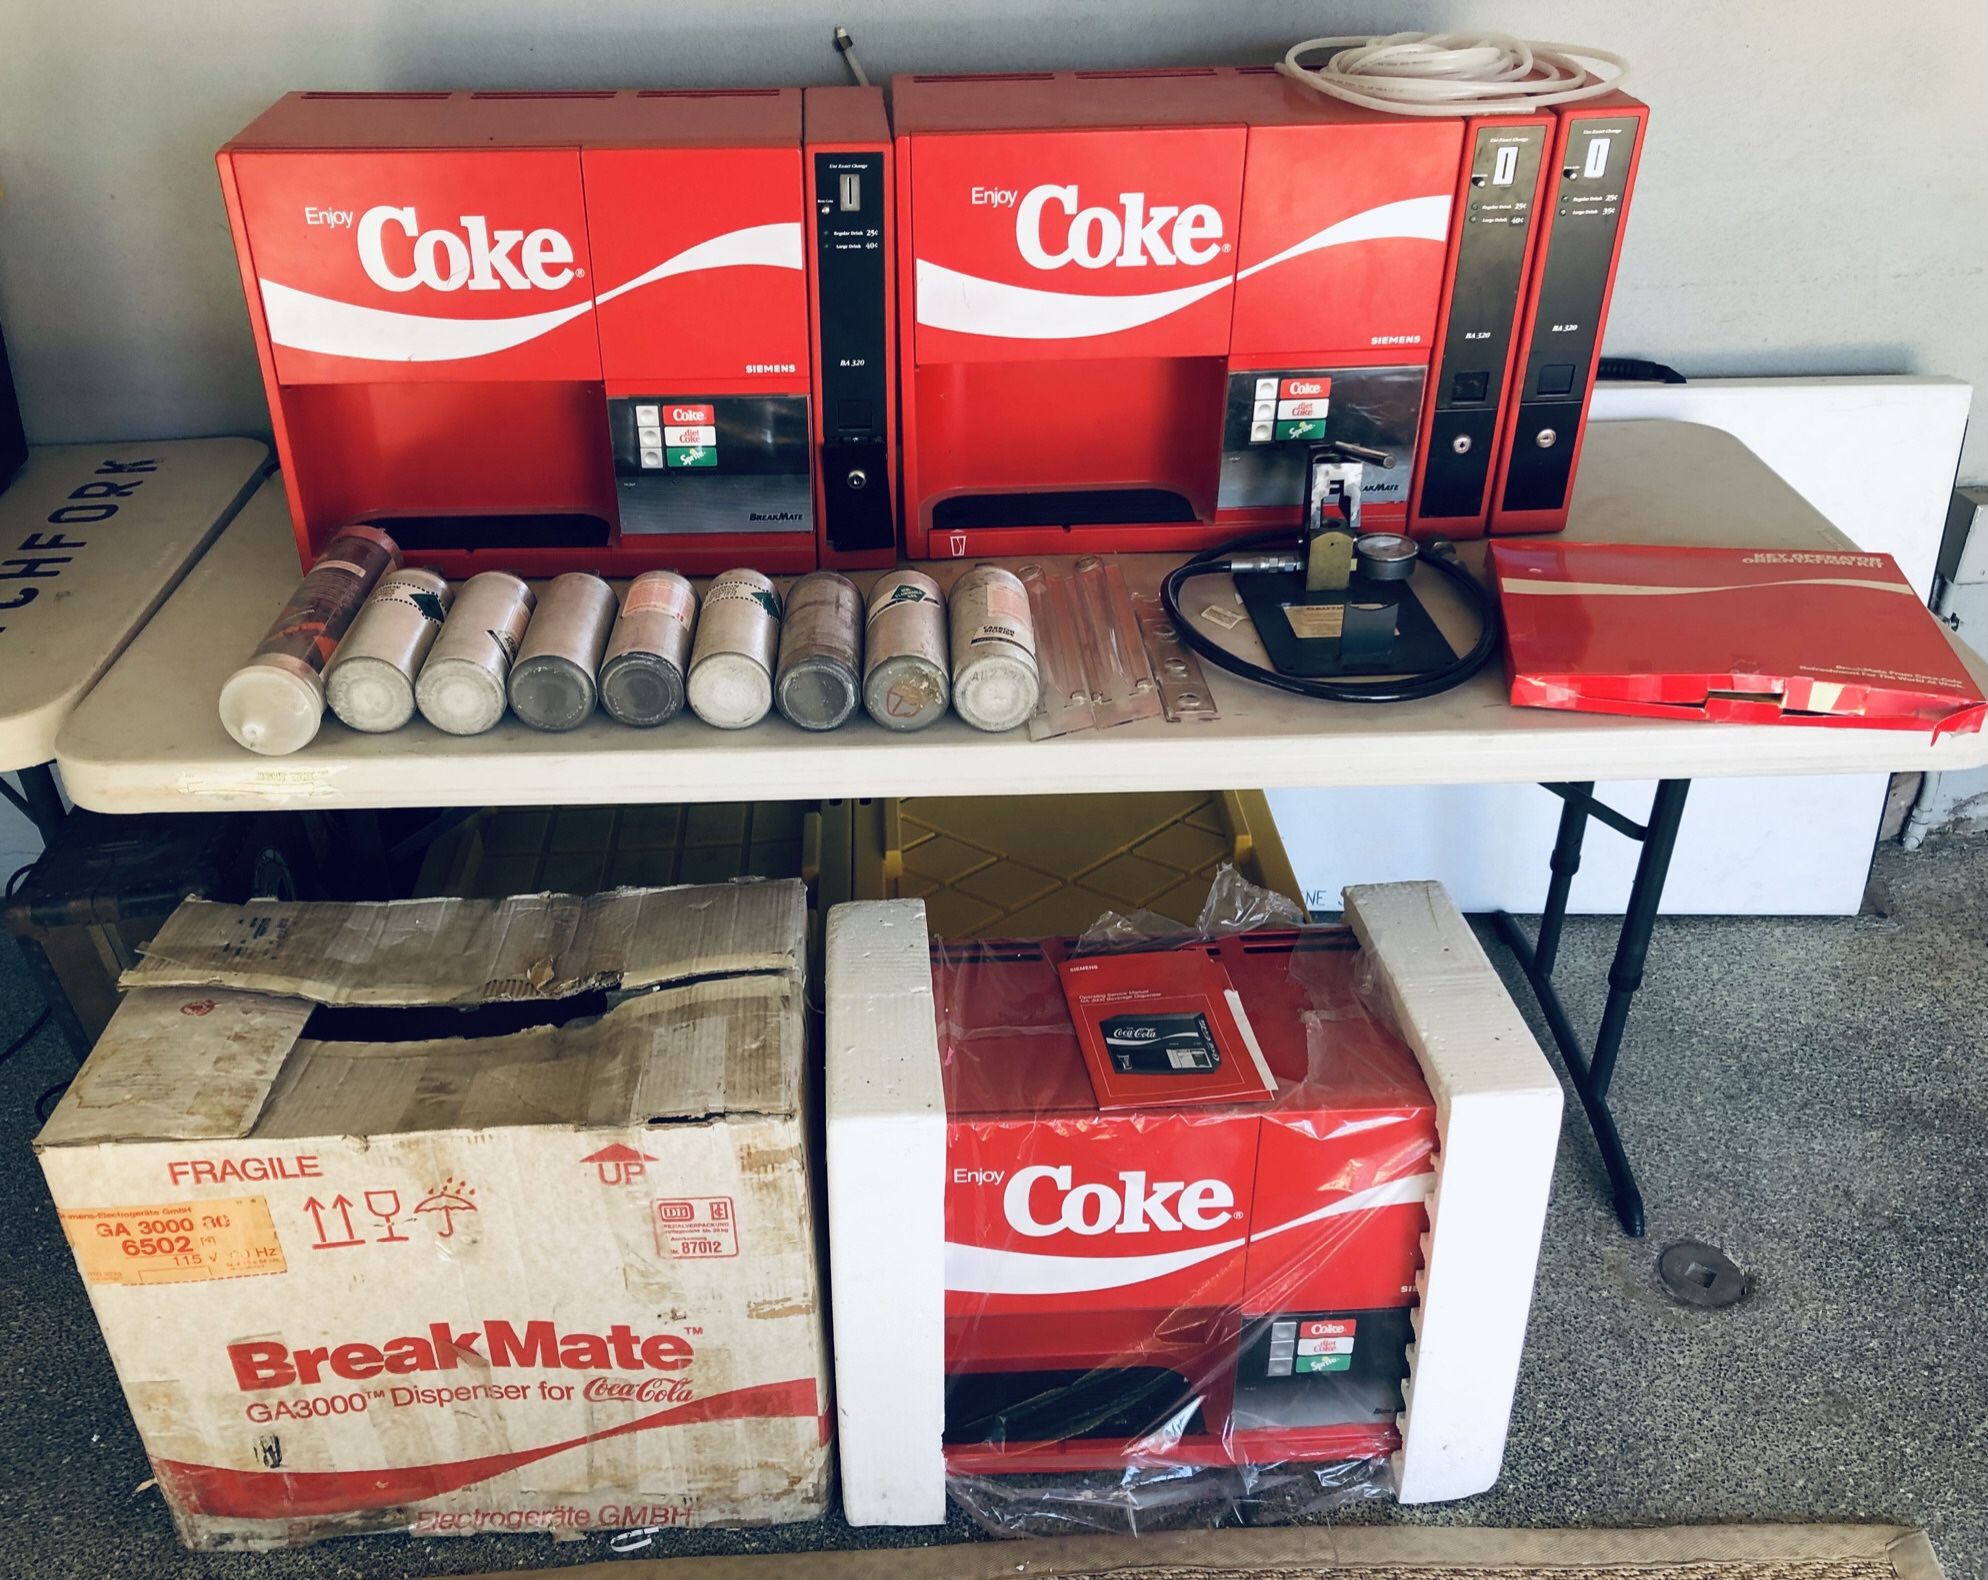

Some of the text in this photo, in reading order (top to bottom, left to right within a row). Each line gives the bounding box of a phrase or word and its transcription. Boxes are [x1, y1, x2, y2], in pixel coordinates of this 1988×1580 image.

[971, 187, 1018, 208] Enjoy
[304, 206, 353, 229] Enjoy
[1563, 324, 1578, 332] 320
[1371, 335, 1421, 345] SIEMENS
[745, 364, 796, 373] SIEMENS
[1289, 382, 1322, 395] Coke
[672, 408, 705, 422] Coke
[1292, 408, 1313, 416] Coke
[679, 434, 701, 443] Coke
[1069, 964, 1098, 973] SIEMENS
[168, 1155, 323, 1186] FRAGILE
[598, 1163, 646, 1186] UP
[953, 1168, 1005, 1186] Enjoy
[162, 1205, 192, 1216] GmbH
[96, 1222, 131, 1237] GA
[137, 1217, 194, 1235] 3000
[121, 1236, 194, 1256] 6502
[256, 1246, 277, 1258] Hz
[682, 1240, 722, 1254] 87012
[173, 1254, 202, 1267] 115
[1310, 1323, 1345, 1335] Coke
[1313, 1344, 1337, 1352] Coke
[390, 1384, 530, 1408] Dispenser
[538, 1381, 574, 1400] for
[583, 1376, 694, 1402] Coca-Cola
[415, 1504, 695, 1532] Electrogeräte GMBH
